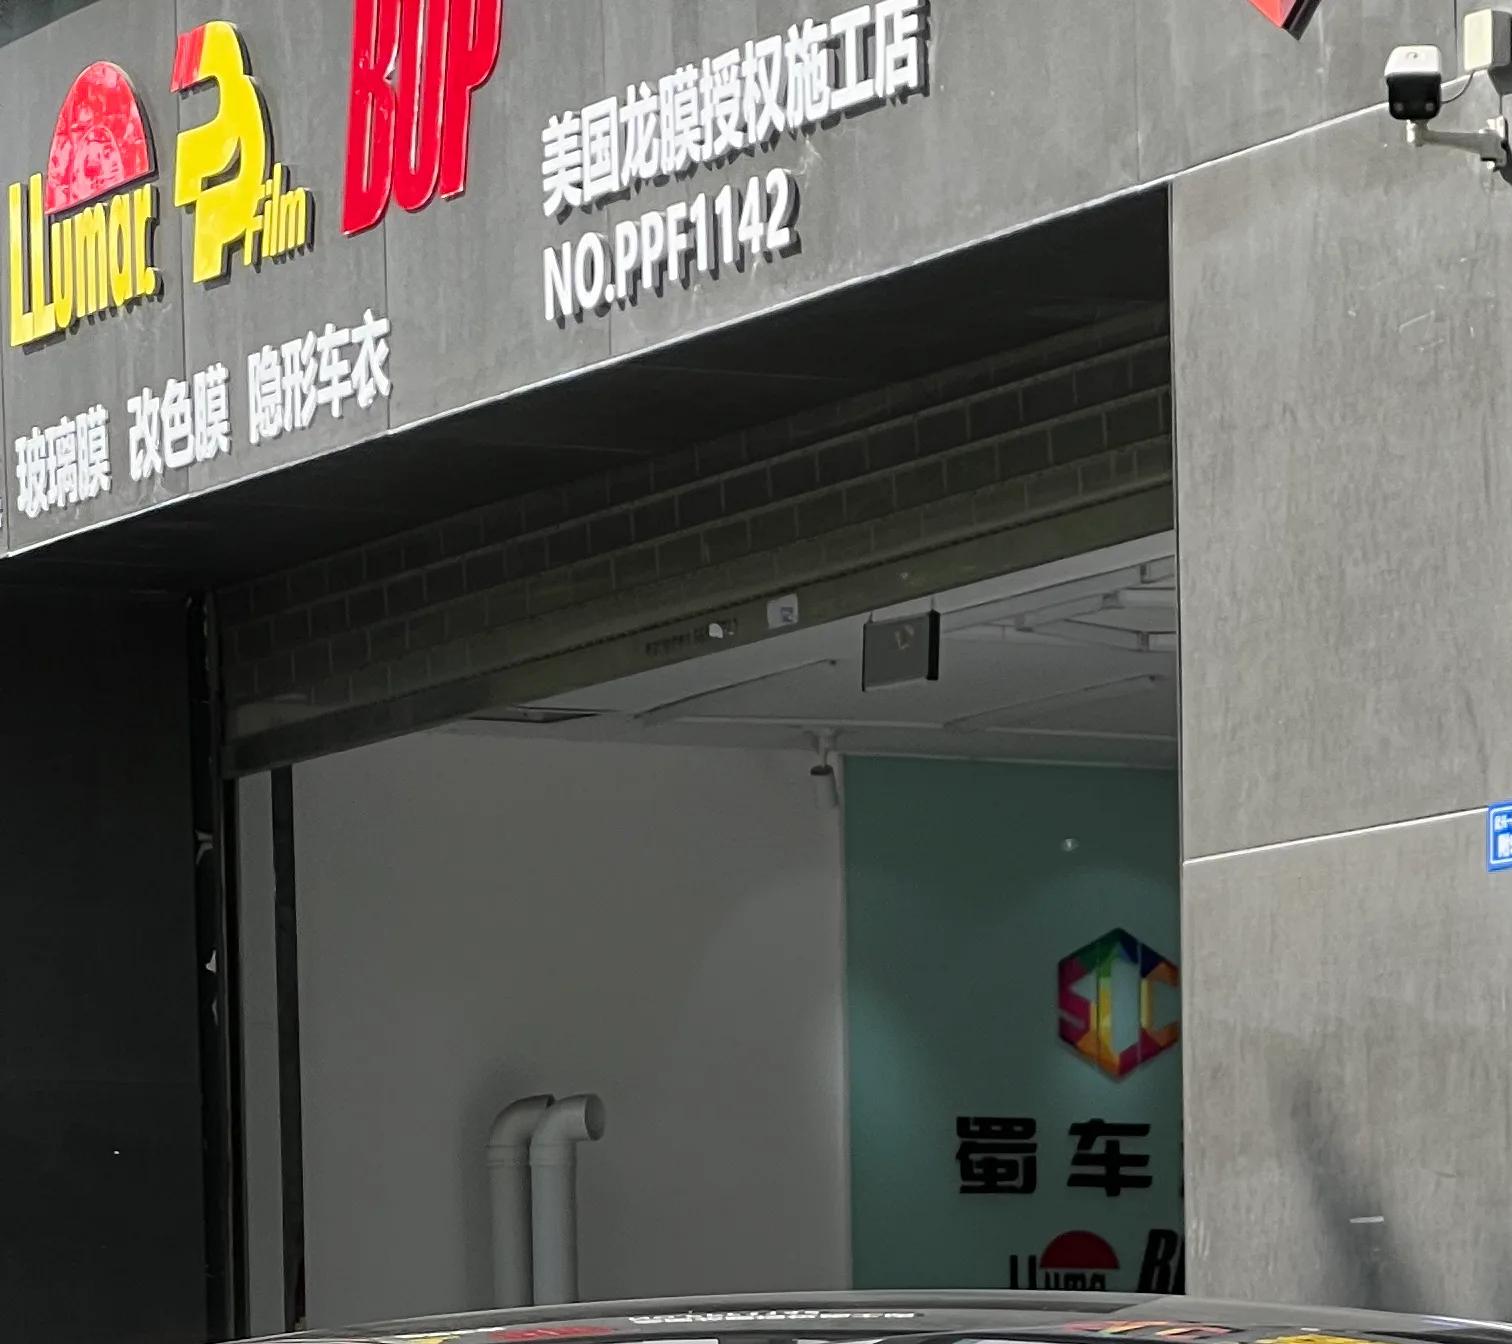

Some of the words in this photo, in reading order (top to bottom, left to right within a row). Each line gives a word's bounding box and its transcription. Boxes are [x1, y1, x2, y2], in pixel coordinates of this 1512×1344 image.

[542, 0, 919, 216] 美国龙膜授权施工店
[543, 168, 790, 320] NO.PPF1142
[15, 404, 112, 518] 玻璃膜
[127, 363, 232, 482] 改色膜
[247, 309, 391, 444] 隐形车衣
[956, 1116, 1185, 1197] 蜀车
